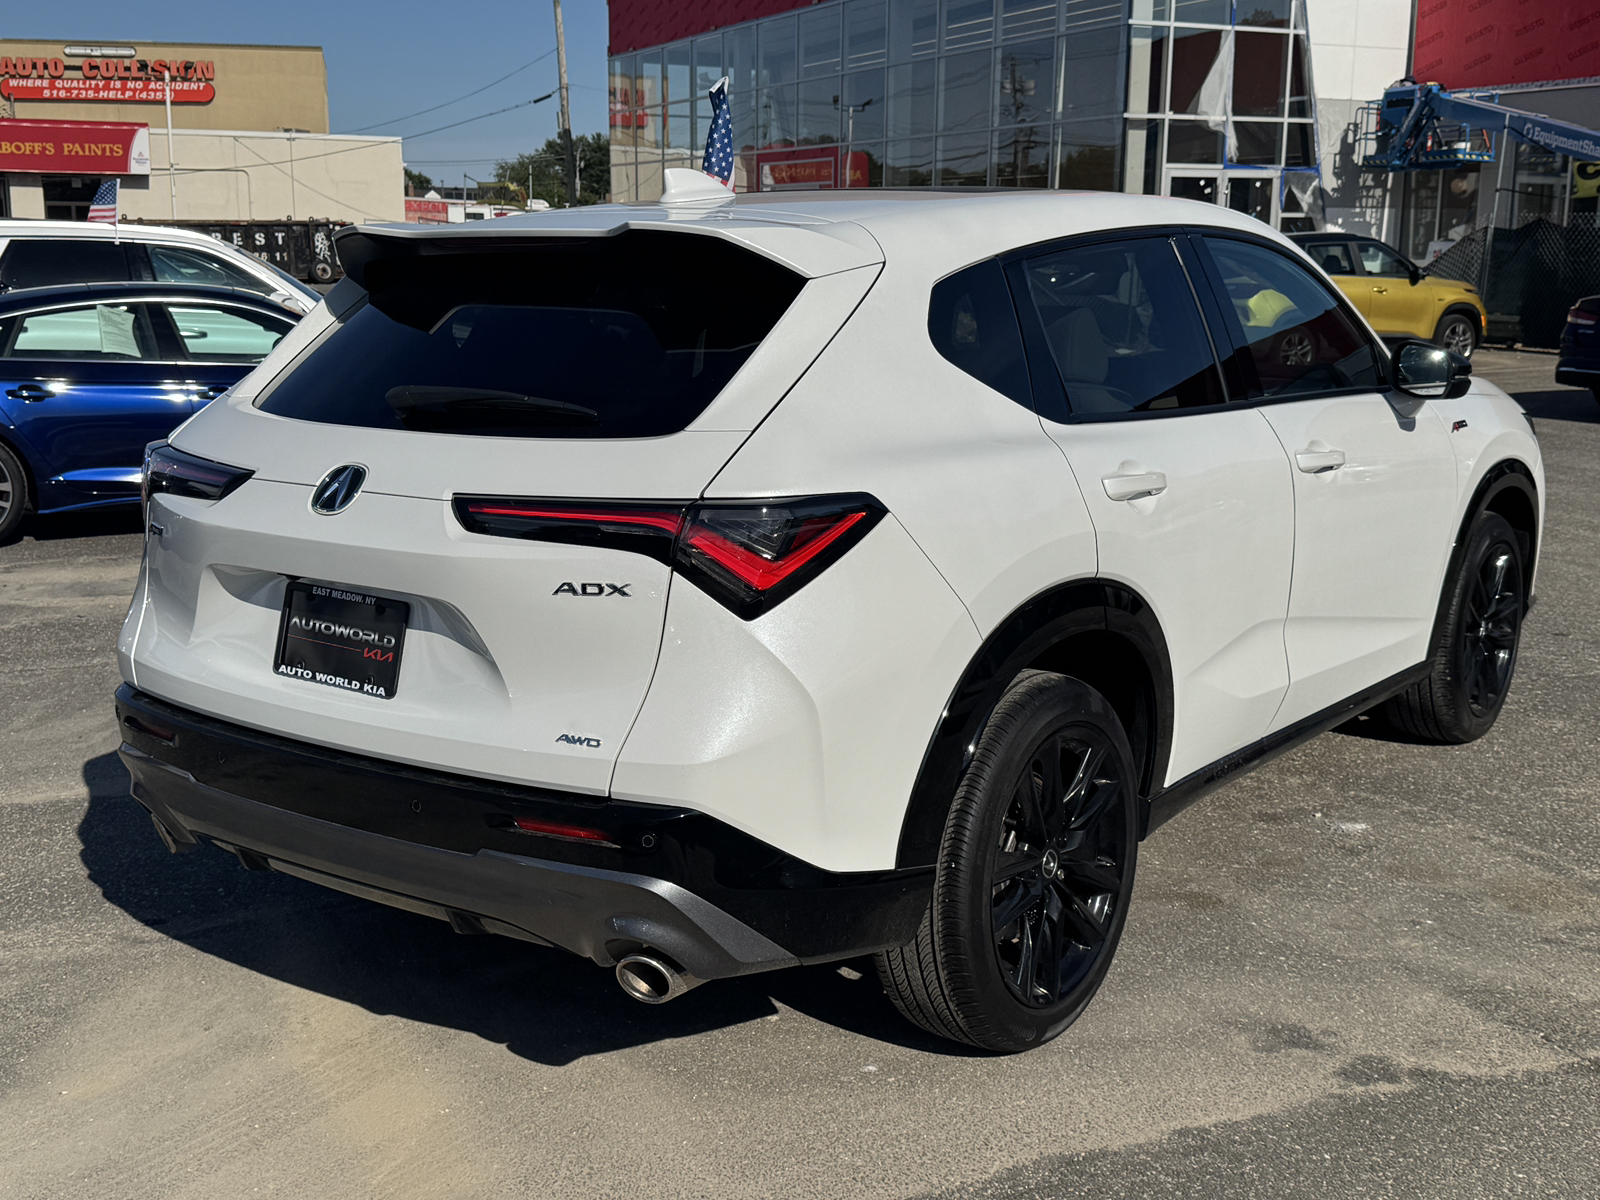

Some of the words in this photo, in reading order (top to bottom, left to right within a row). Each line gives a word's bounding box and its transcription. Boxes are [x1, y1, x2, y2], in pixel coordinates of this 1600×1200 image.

[0, 57, 64, 78] AUTO
[82, 58, 215, 81] COLLISION
[9, 79, 50, 87] WHERE
[55, 80, 105, 88] QUALITY
[110, 81, 121, 89] IS
[43, 89, 133, 98] 516-735-HELP
[0, 141, 55, 156] BOFF'S
[63, 143, 123, 156] PAINTS
[312, 586, 331, 597] EAST
[365, 597, 376, 606] NY
[552, 581, 632, 597] ADX
[289, 615, 396, 648] AUTOWORLD
[278, 664, 312, 679] AUTO
[315, 672, 360, 690] WORLD
[363, 683, 386, 697] KIA
[555, 733, 602, 749] AWD
